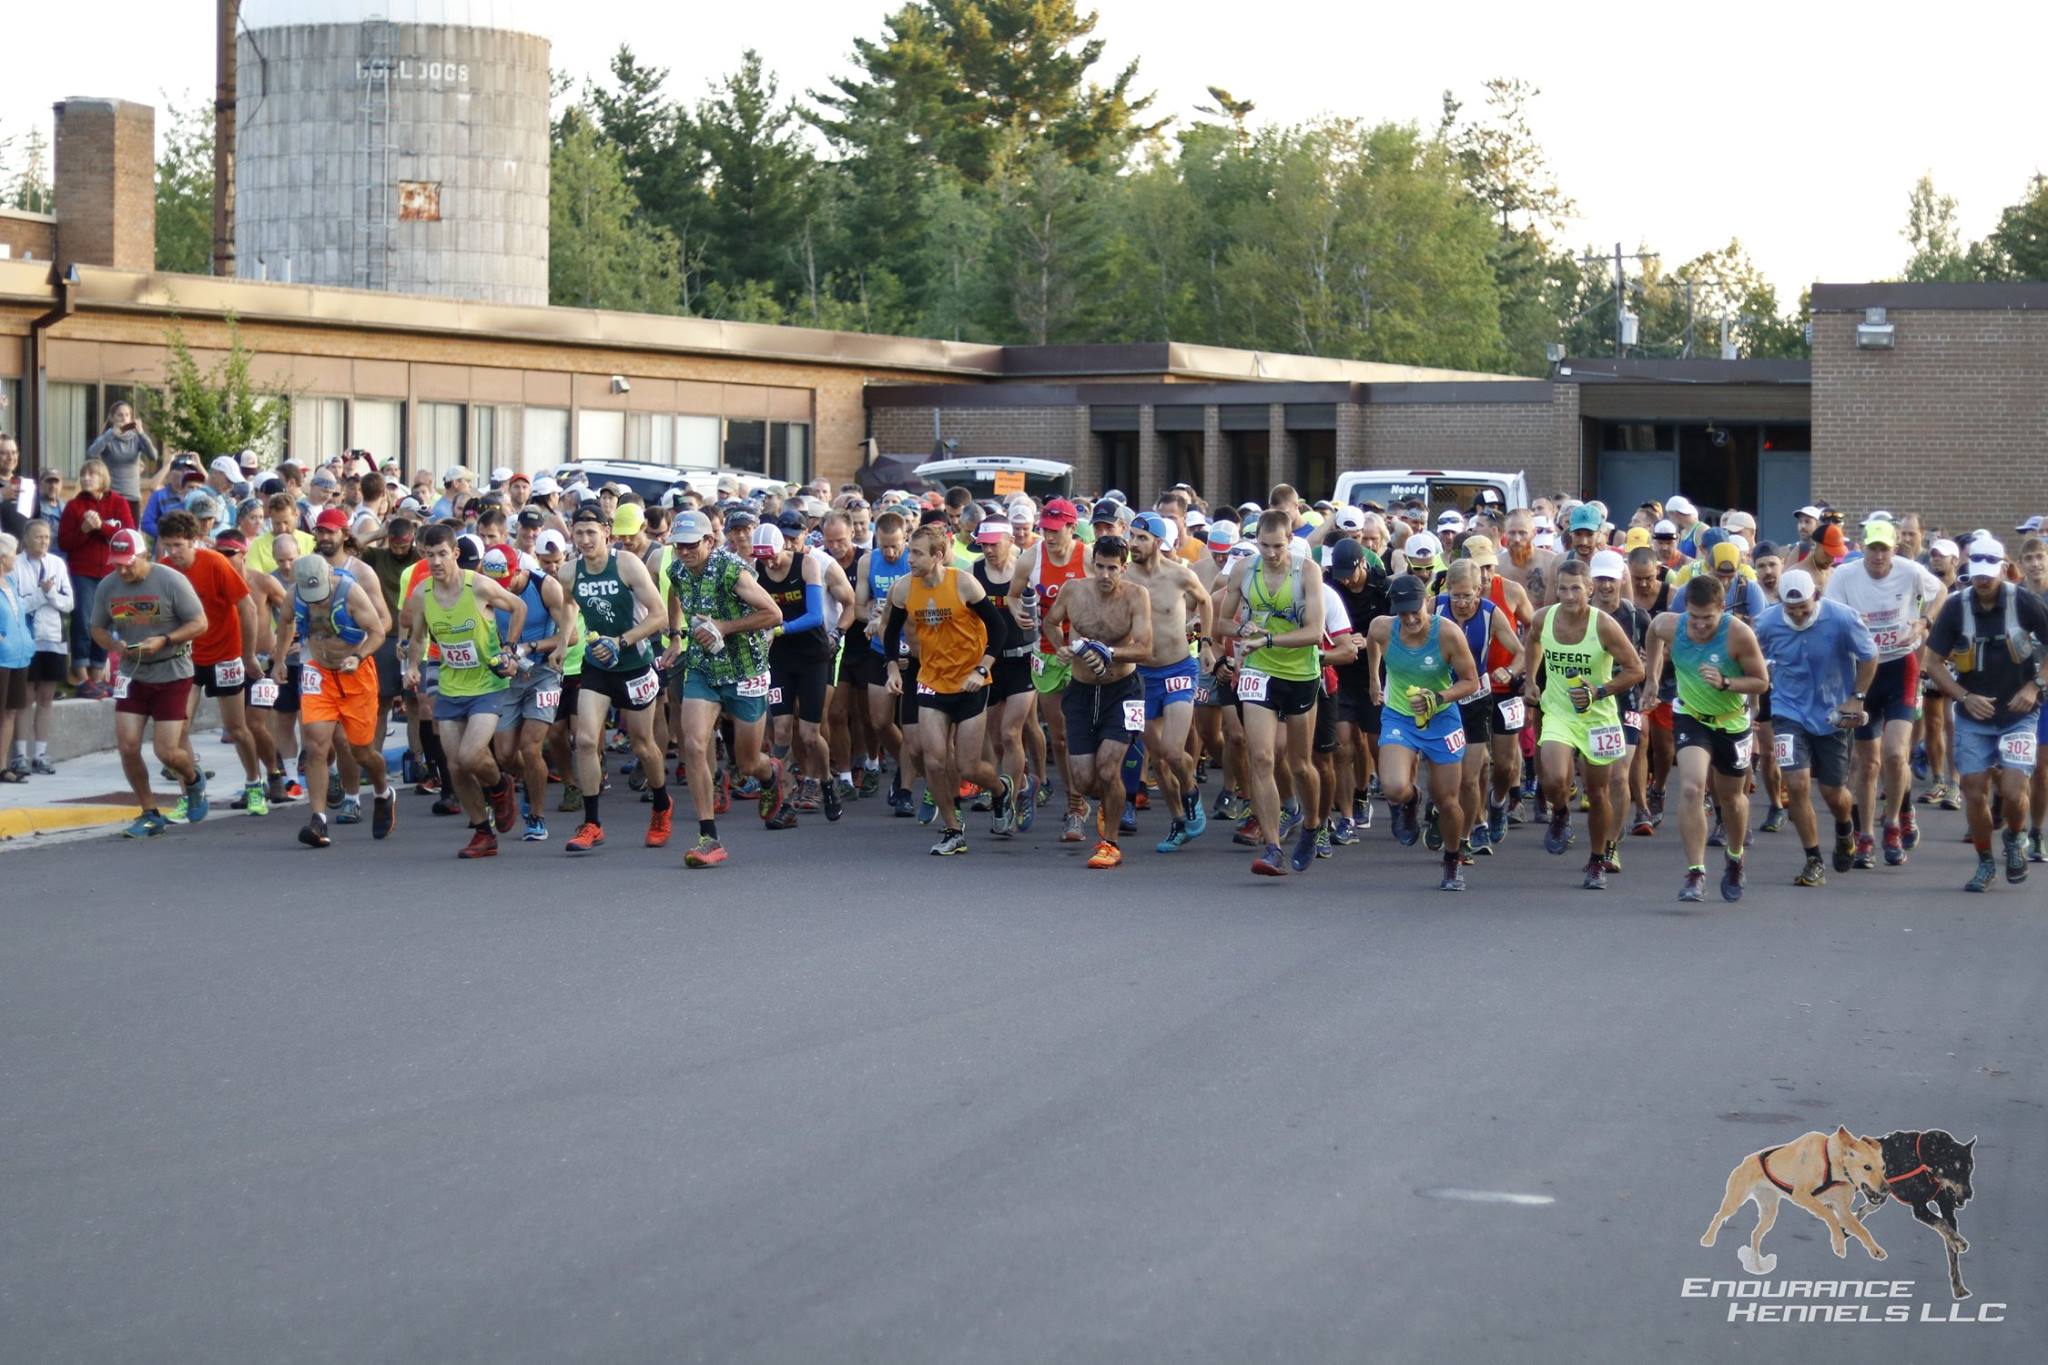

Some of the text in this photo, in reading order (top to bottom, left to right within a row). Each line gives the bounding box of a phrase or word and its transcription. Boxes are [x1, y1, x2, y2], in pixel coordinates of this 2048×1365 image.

[1391, 484, 1418, 494] Need
[578, 580, 619, 597] SCTC
[915, 608, 953, 618] NORTHWOODS
[1873, 631, 1898, 646] 425
[447, 649, 471, 662] 426
[1545, 649, 1592, 664] DEFEAT
[222, 667, 242, 681] 364
[636, 681, 656, 699] 104
[744, 675, 768, 690] 335
[1166, 677, 1190, 692] 107
[1239, 676, 1260, 692] 106
[256, 685, 276, 700] 182
[538, 692, 560, 707] 190
[1597, 732, 1622, 751] 129
[2006, 740, 2030, 756] 302
